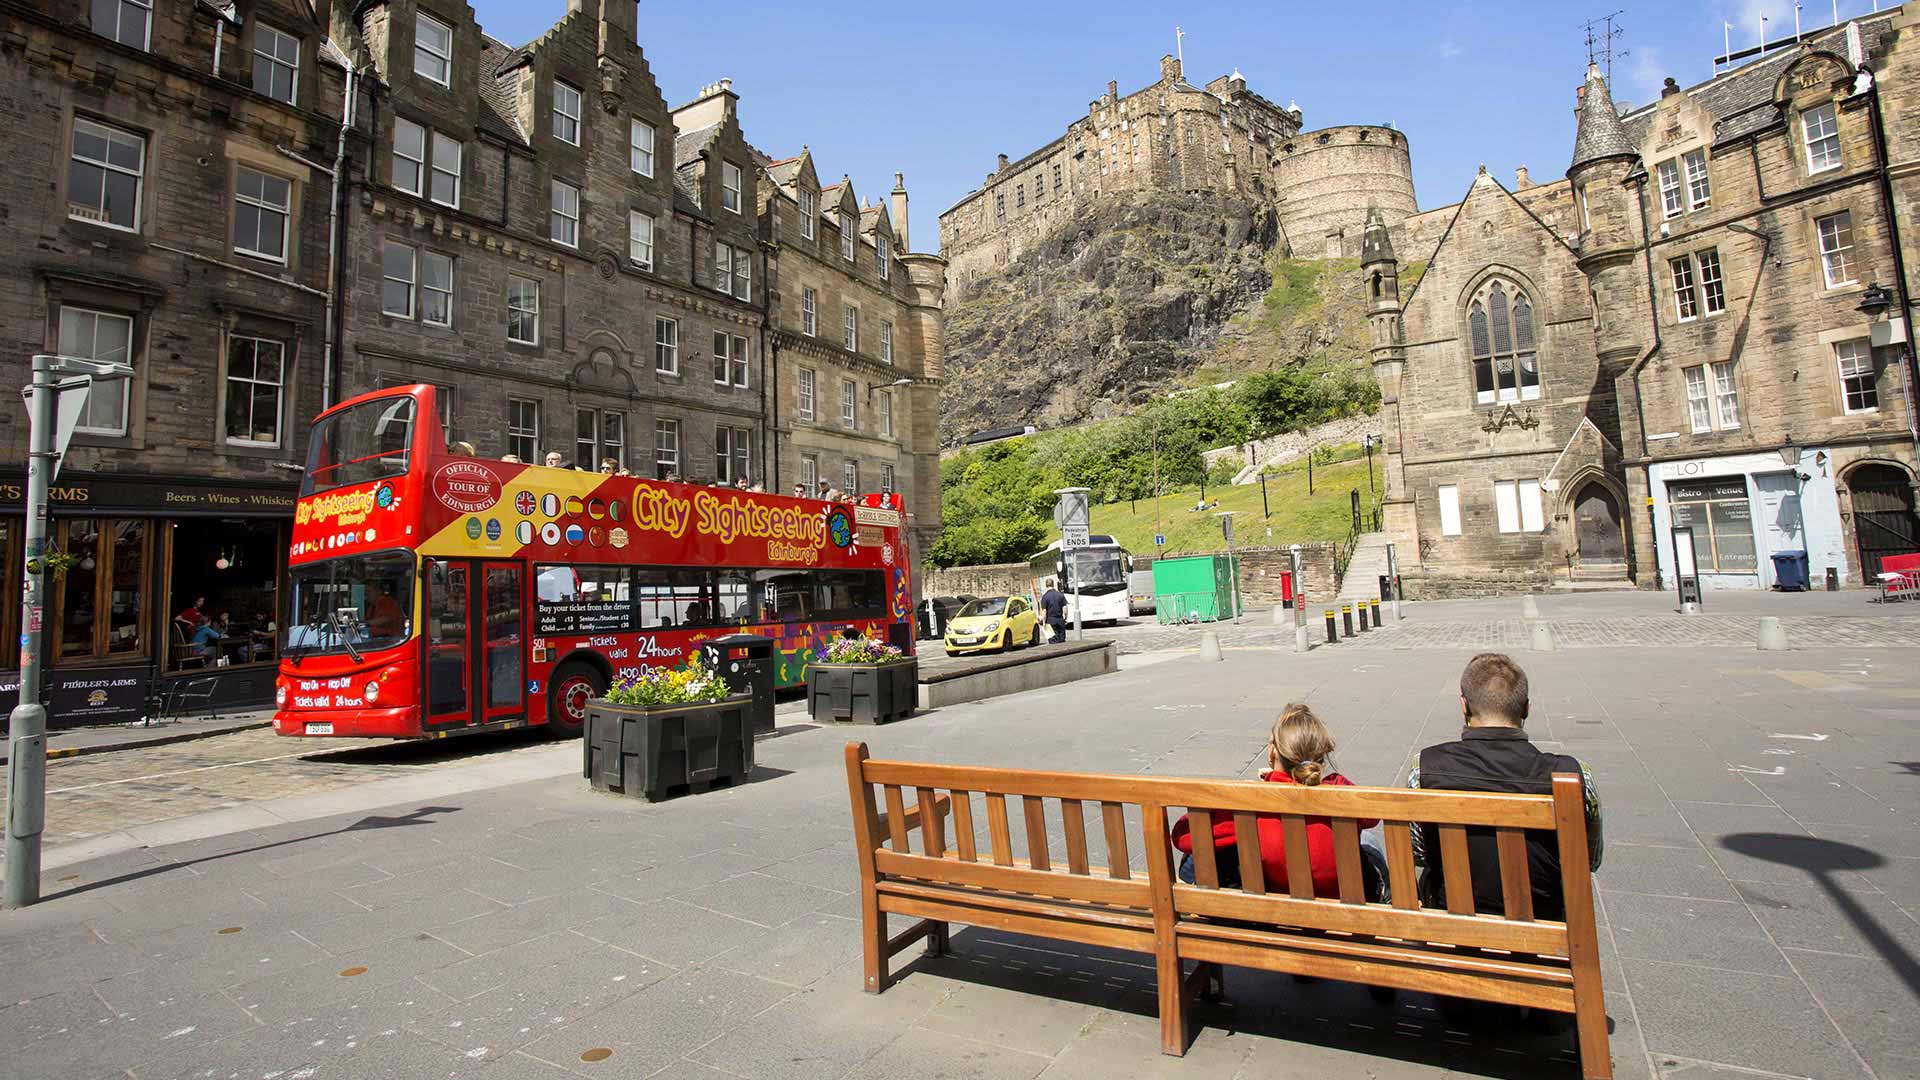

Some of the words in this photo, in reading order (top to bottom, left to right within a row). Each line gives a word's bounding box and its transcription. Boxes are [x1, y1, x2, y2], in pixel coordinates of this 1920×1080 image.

[446, 464, 488, 479] OFFICIAL
[1677, 462, 1705, 475] LOT
[47, 487, 88, 501] RMS
[448, 482, 475, 492] TOUR
[477, 485, 490, 493] OF
[1716, 487, 1744, 495] Venue
[166, 491, 196, 502] Beers
[207, 493, 240, 504] Wines
[251, 495, 294, 506] Whiskies
[441, 493, 496, 512] EDINBURGH
[312, 490, 376, 523] Sightseeing
[632, 483, 691, 539] City
[695, 490, 827, 549] Sightseeing
[768, 540, 818, 565] Edinburgh
[539, 605, 552, 614] Buy
[553, 606, 568, 614] your
[569, 603, 586, 611] ticket
[587, 603, 602, 611] from
[579, 623, 595, 631] Family
[533, 638, 545, 648] 501
[590, 636, 617, 647] Tickets
[609, 648, 628, 658] valid
[638, 635, 658, 658] 24
[658, 646, 682, 657] hours
[619, 666, 639, 679] Hop
[0, 683, 20, 692] ARM
[62, 680, 109, 689] FIDDLER'S
[110, 678, 137, 687] ARMS
[336, 695, 344, 706] 24
[345, 698, 363, 706] hours
